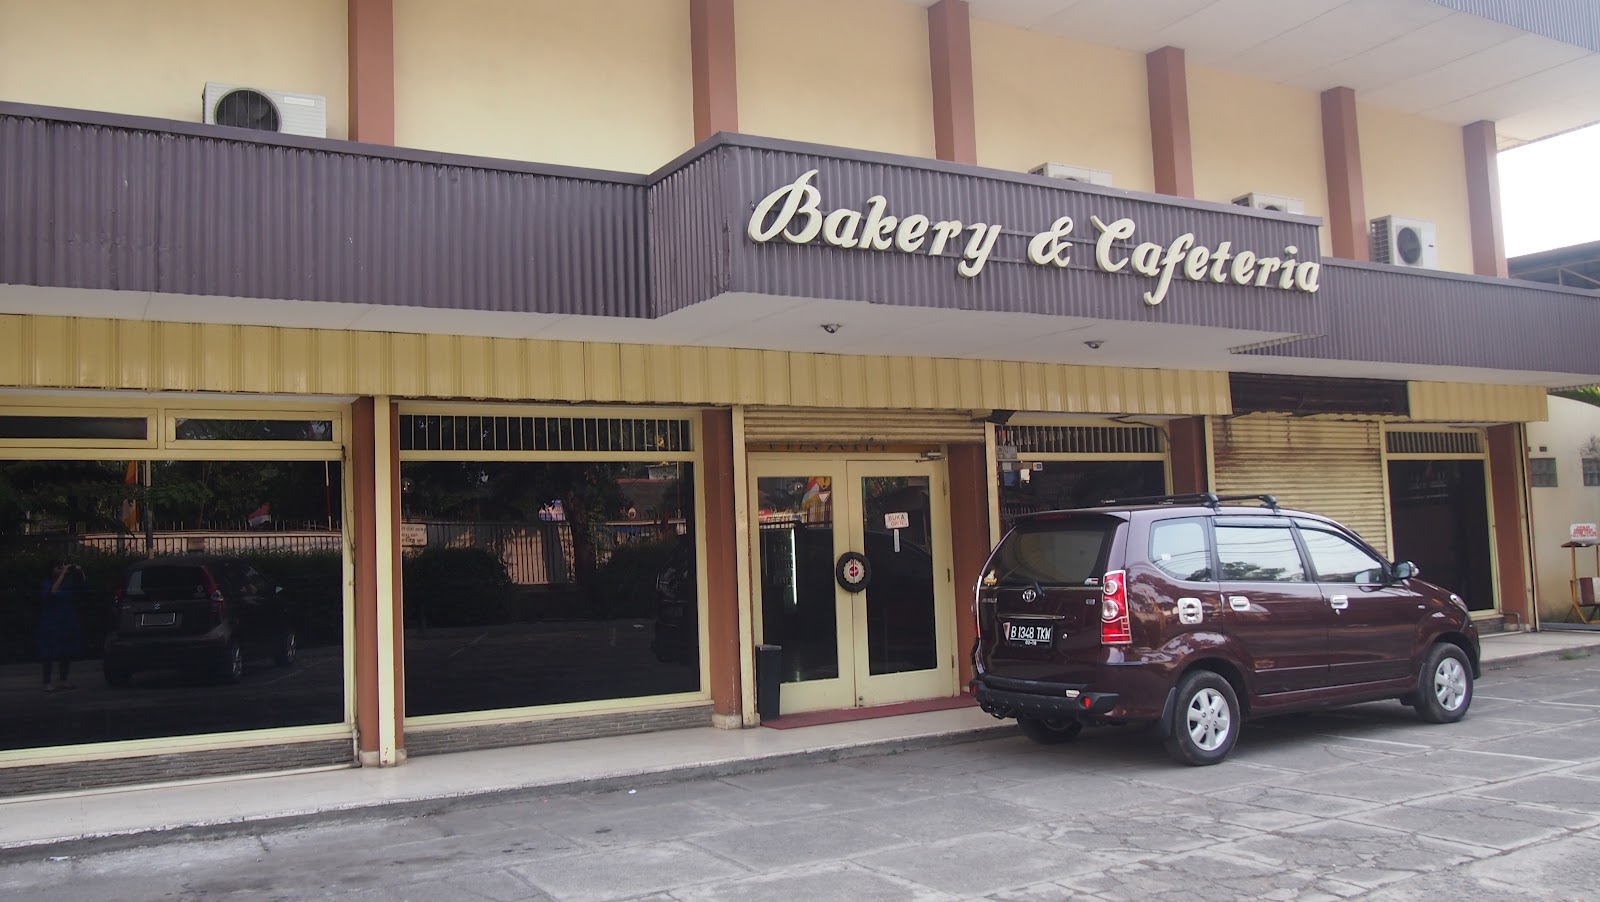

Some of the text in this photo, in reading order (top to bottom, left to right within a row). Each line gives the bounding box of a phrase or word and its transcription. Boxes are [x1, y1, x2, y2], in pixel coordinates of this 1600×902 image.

[747, 168, 1320, 306] Bakery & Cafeteria
[1010, 625, 1017, 638] B
[1018, 626, 1035, 639] 1348
